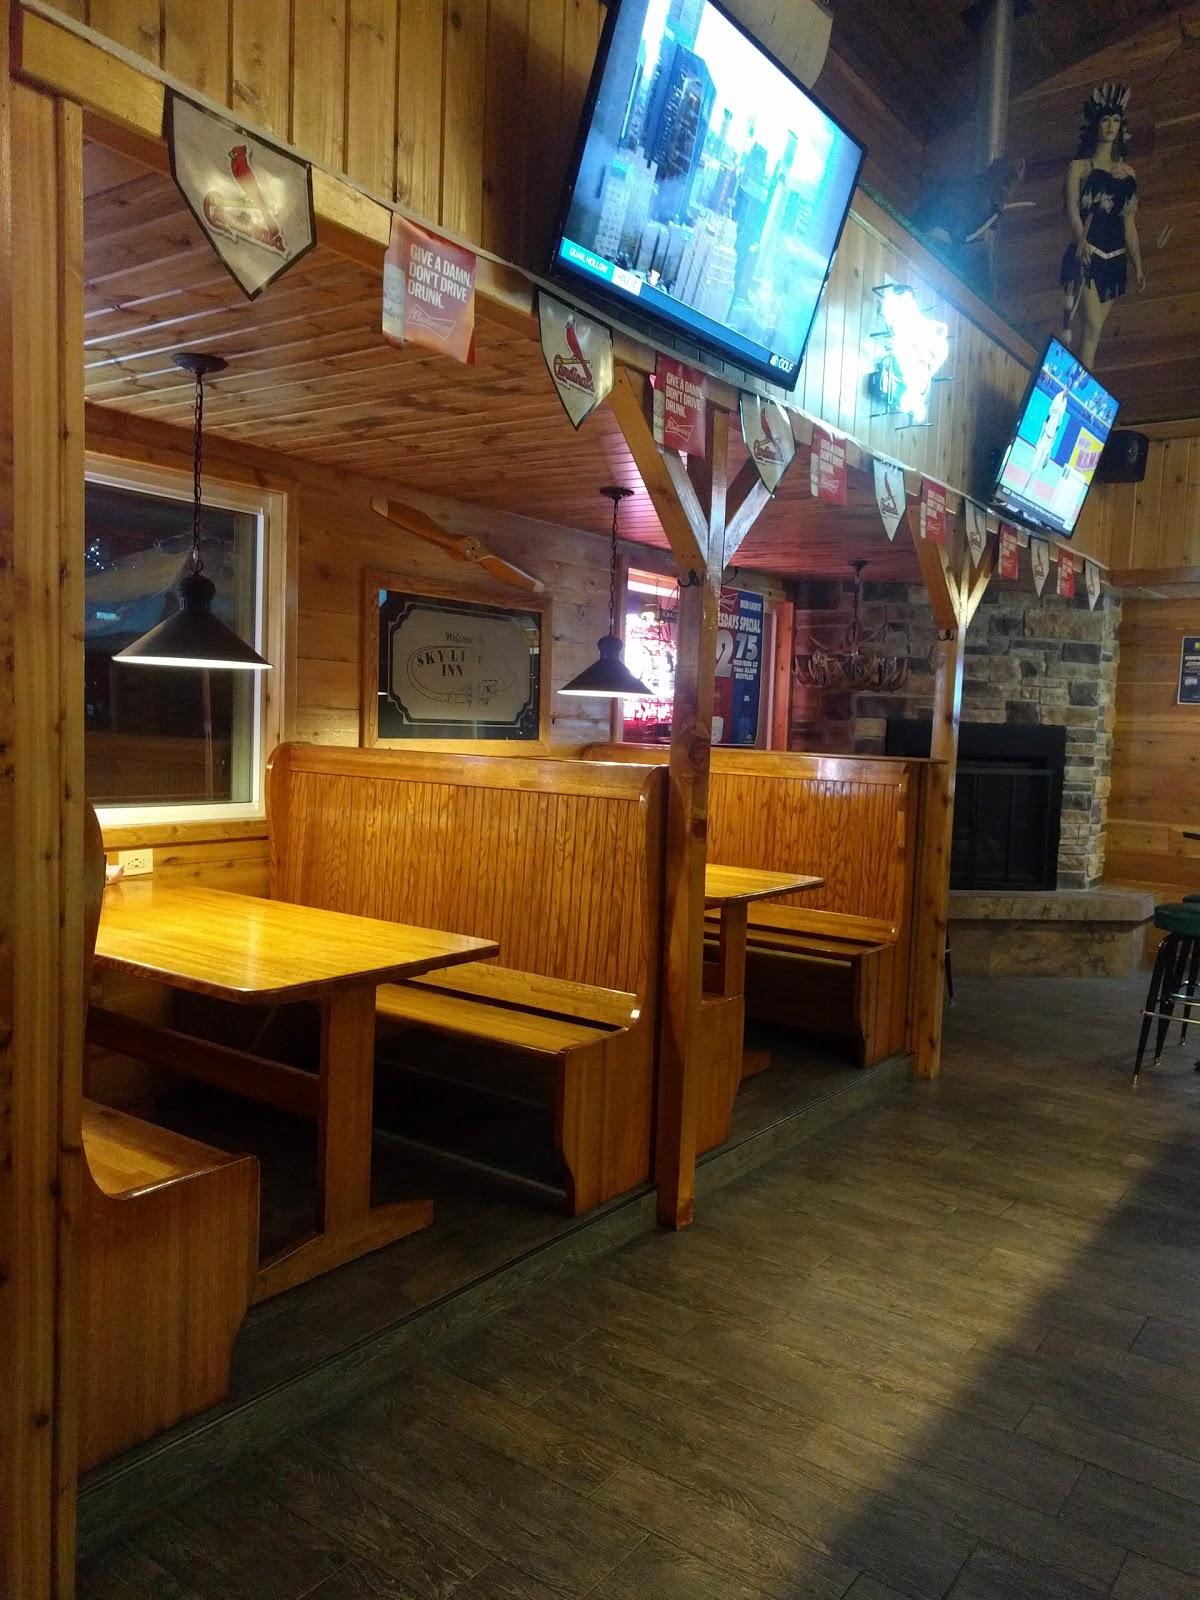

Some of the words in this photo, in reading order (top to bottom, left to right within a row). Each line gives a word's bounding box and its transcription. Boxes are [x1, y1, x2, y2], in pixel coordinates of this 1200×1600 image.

[410, 244, 434, 268] GIVE
[434, 258, 441, 273] A
[443, 260, 472, 289] DAMN.
[409, 262, 439, 287] DON'T
[440, 277, 467, 303] DRIVE
[408, 279, 444, 309] DRUNK.
[778, 358, 794, 373] GOLF
[666, 373, 680, 389] GIVE
[680, 379, 684, 391] A
[666, 385, 683, 404] DON'T
[684, 393, 702, 411] DRIVE
[739, 615, 761, 634] SPECIAL
[416, 649, 486, 667] SKYLI
[735, 633, 758, 661] 75
[442, 664, 464, 677] INN
